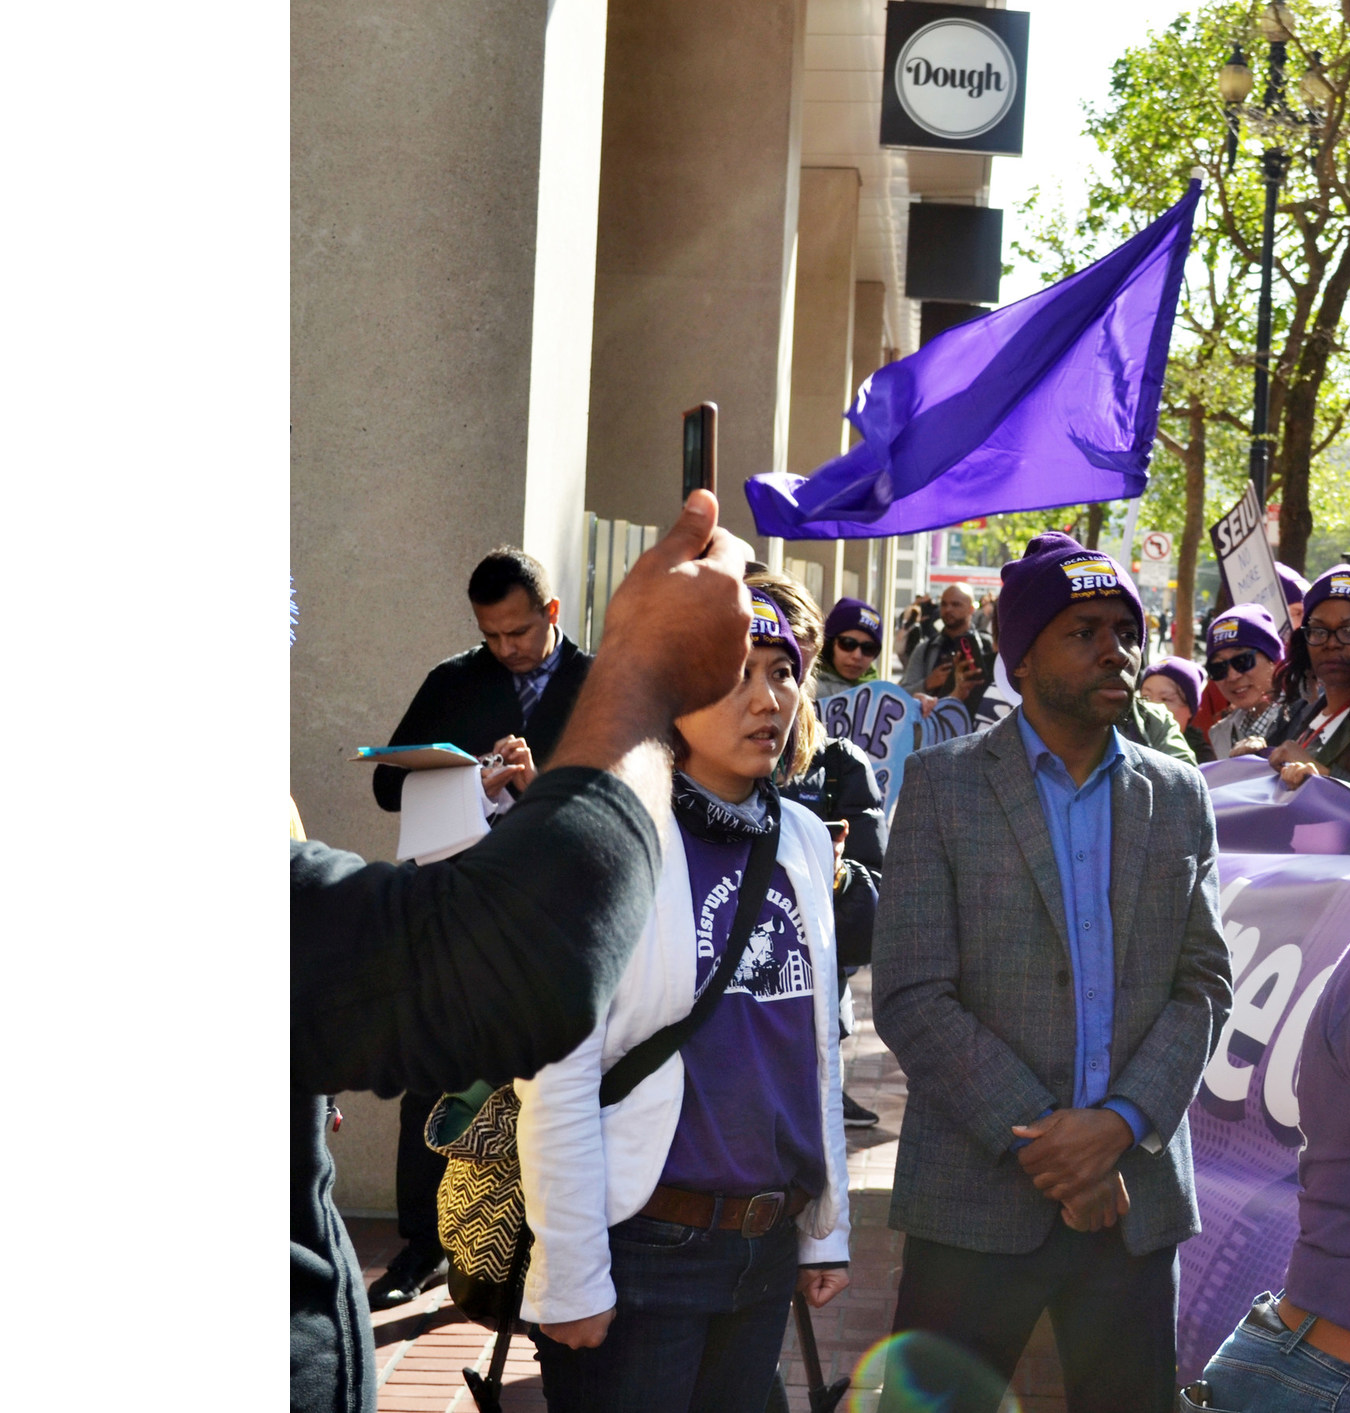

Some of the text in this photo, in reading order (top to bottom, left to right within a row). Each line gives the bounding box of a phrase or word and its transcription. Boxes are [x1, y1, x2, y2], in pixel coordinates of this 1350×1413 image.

[906, 57, 1008, 99] Dough
[1218, 489, 1257, 558] SEIU
[1060, 556, 1088, 567] LOCAL
[1071, 575, 1117, 592] SEIU
[750, 618, 780, 636] EIU
[1213, 631, 1238, 644] SEIU
[697, 876, 737, 958] Disrupt
